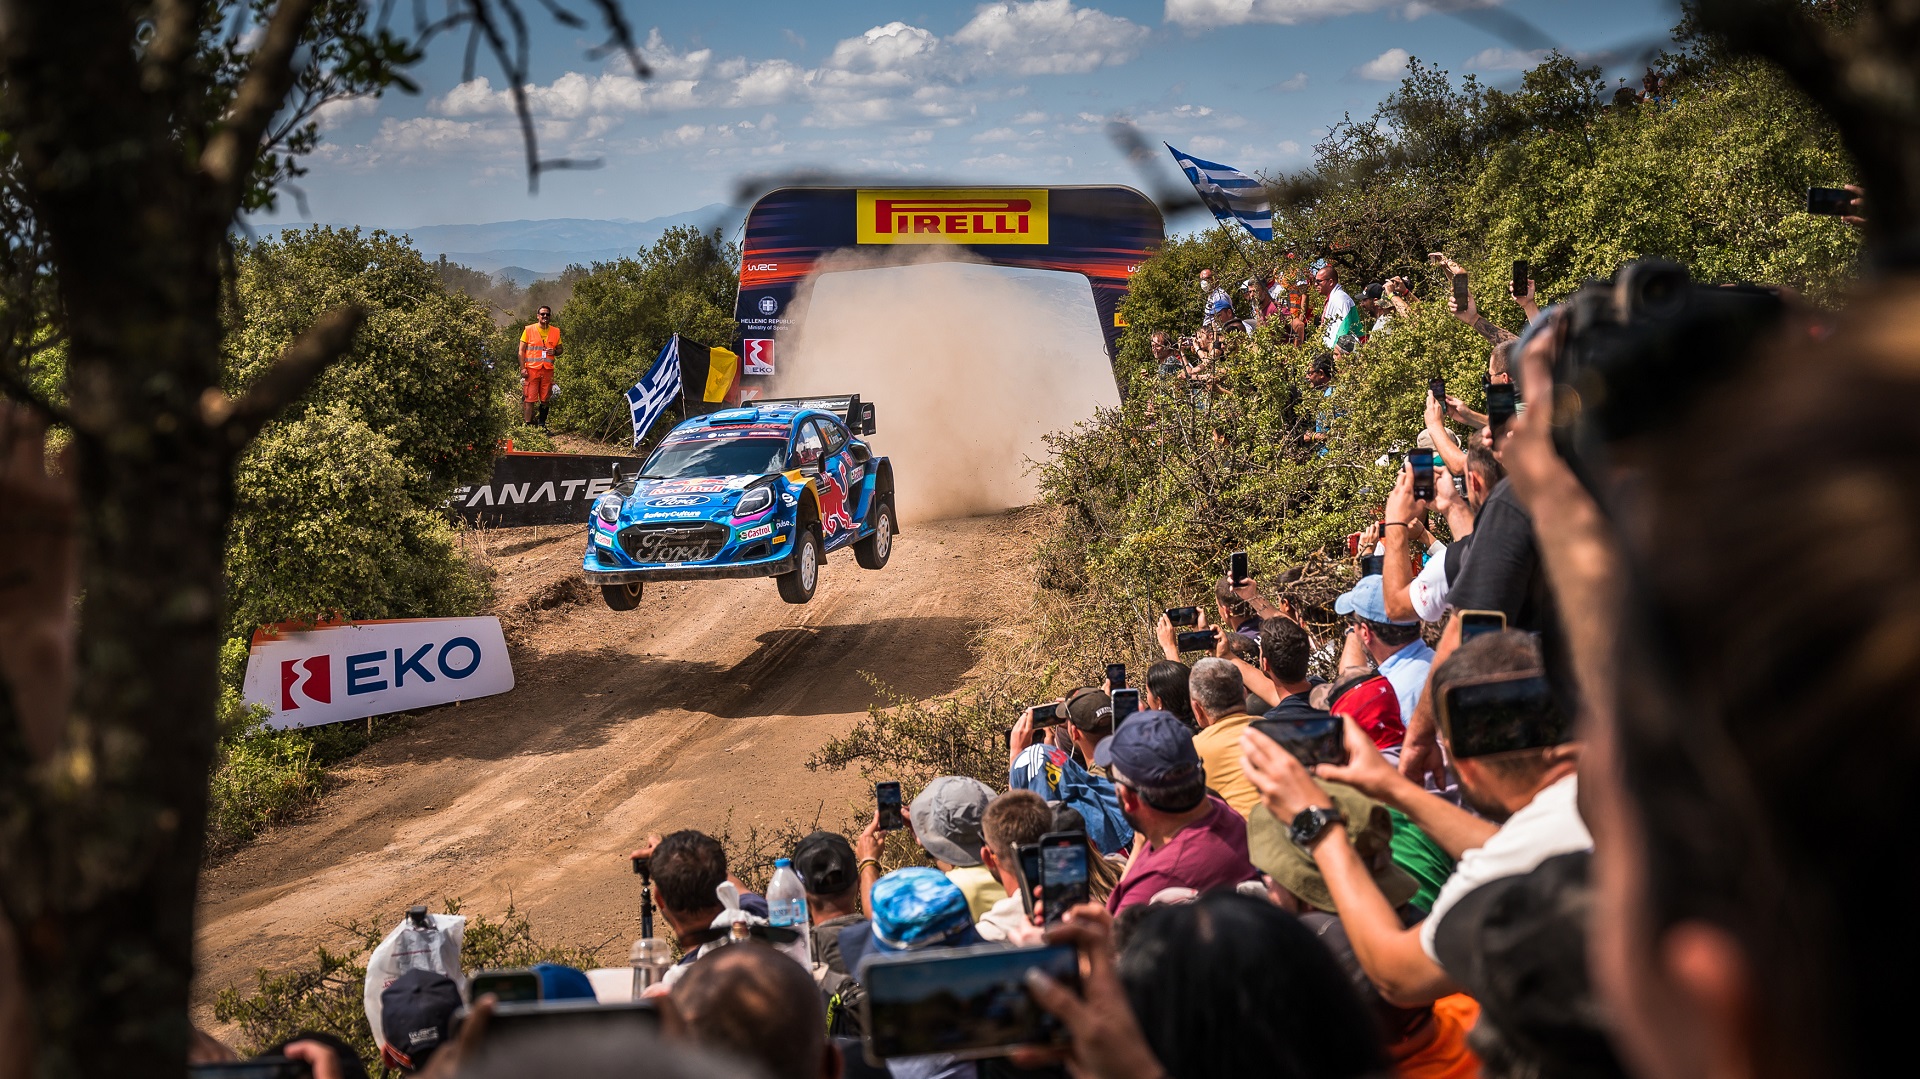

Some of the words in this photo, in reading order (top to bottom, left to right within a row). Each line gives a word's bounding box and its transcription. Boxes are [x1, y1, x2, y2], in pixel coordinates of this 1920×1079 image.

[875, 199, 1032, 234] PIRELLI
[747, 263, 778, 271] WRC
[655, 495, 702, 506] Ford
[643, 510, 701, 519] SafetyCulture
[747, 525, 771, 538] Castrol
[635, 533, 711, 563] Ford
[346, 636, 482, 696] EKO
